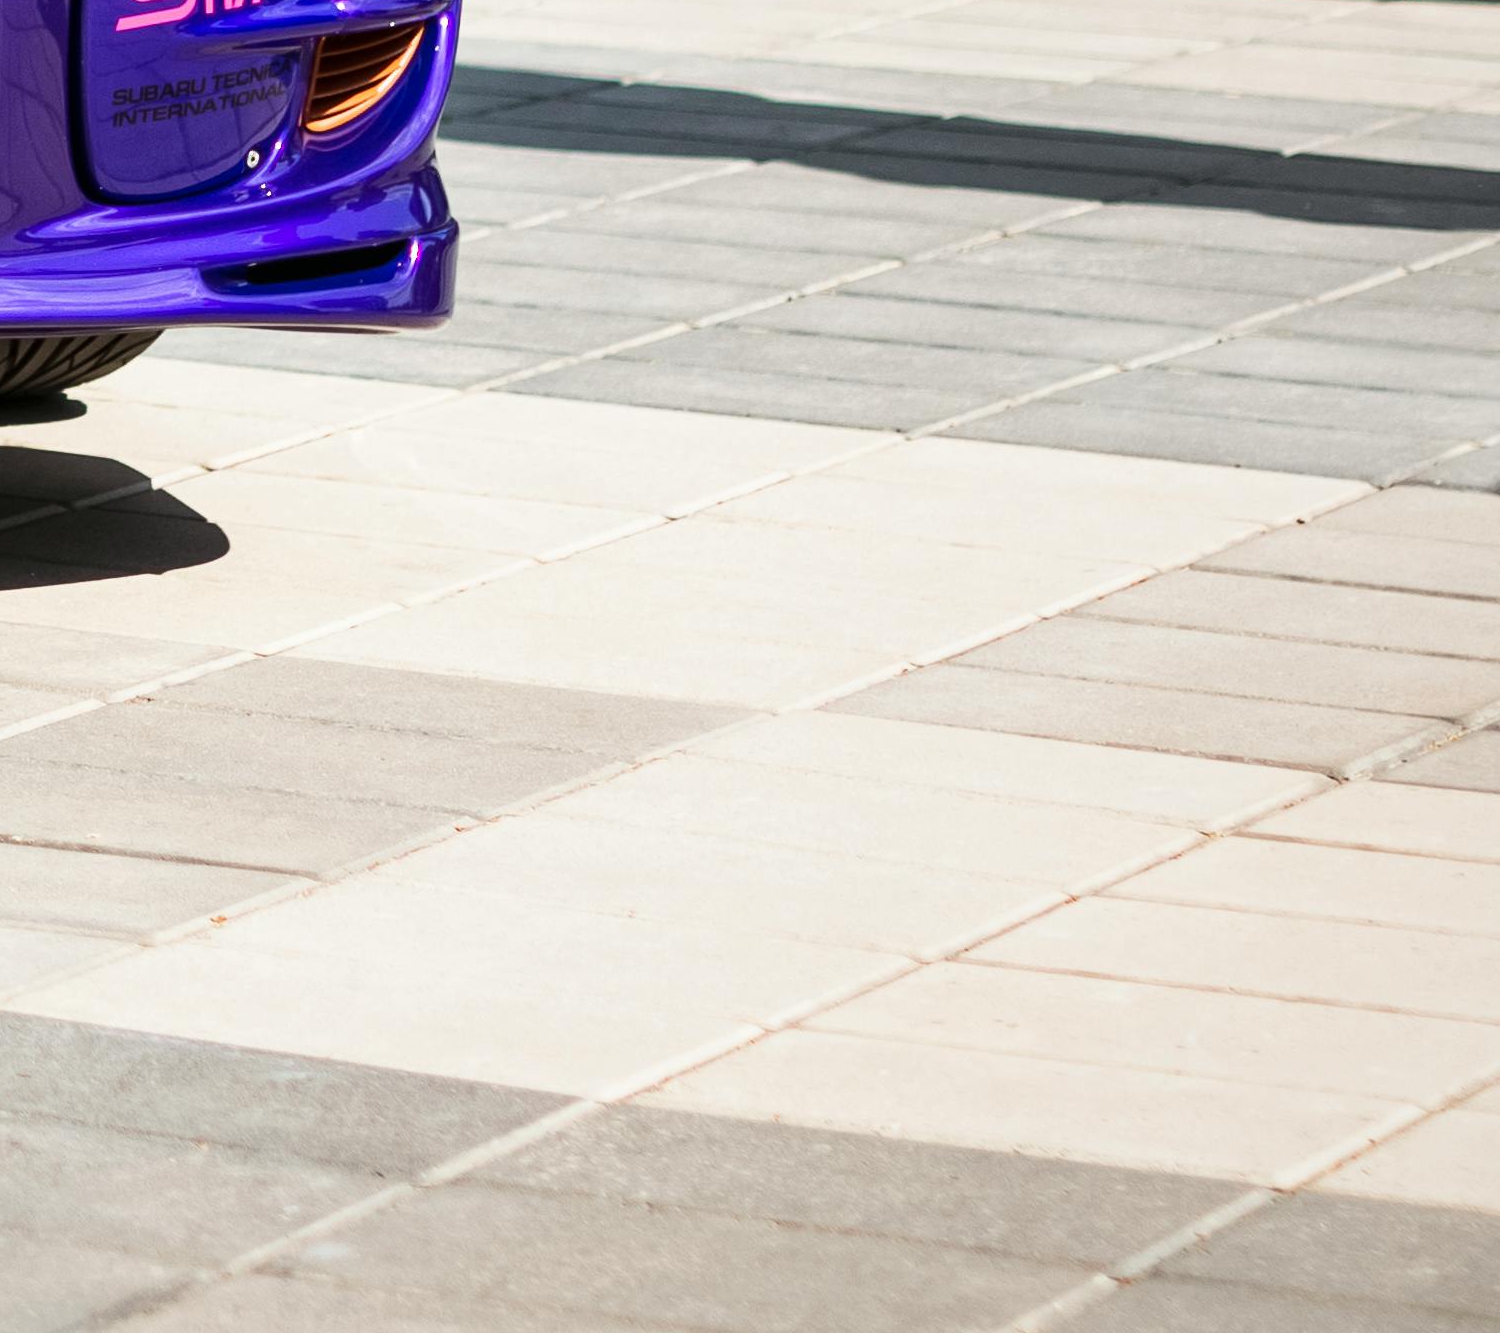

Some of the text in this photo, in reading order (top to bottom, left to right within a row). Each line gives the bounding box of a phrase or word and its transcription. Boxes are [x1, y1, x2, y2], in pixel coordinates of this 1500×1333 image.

[112, 59, 294, 106] SUBARU TECNICA
[112, 83, 287, 129] INTERNATIONAL
